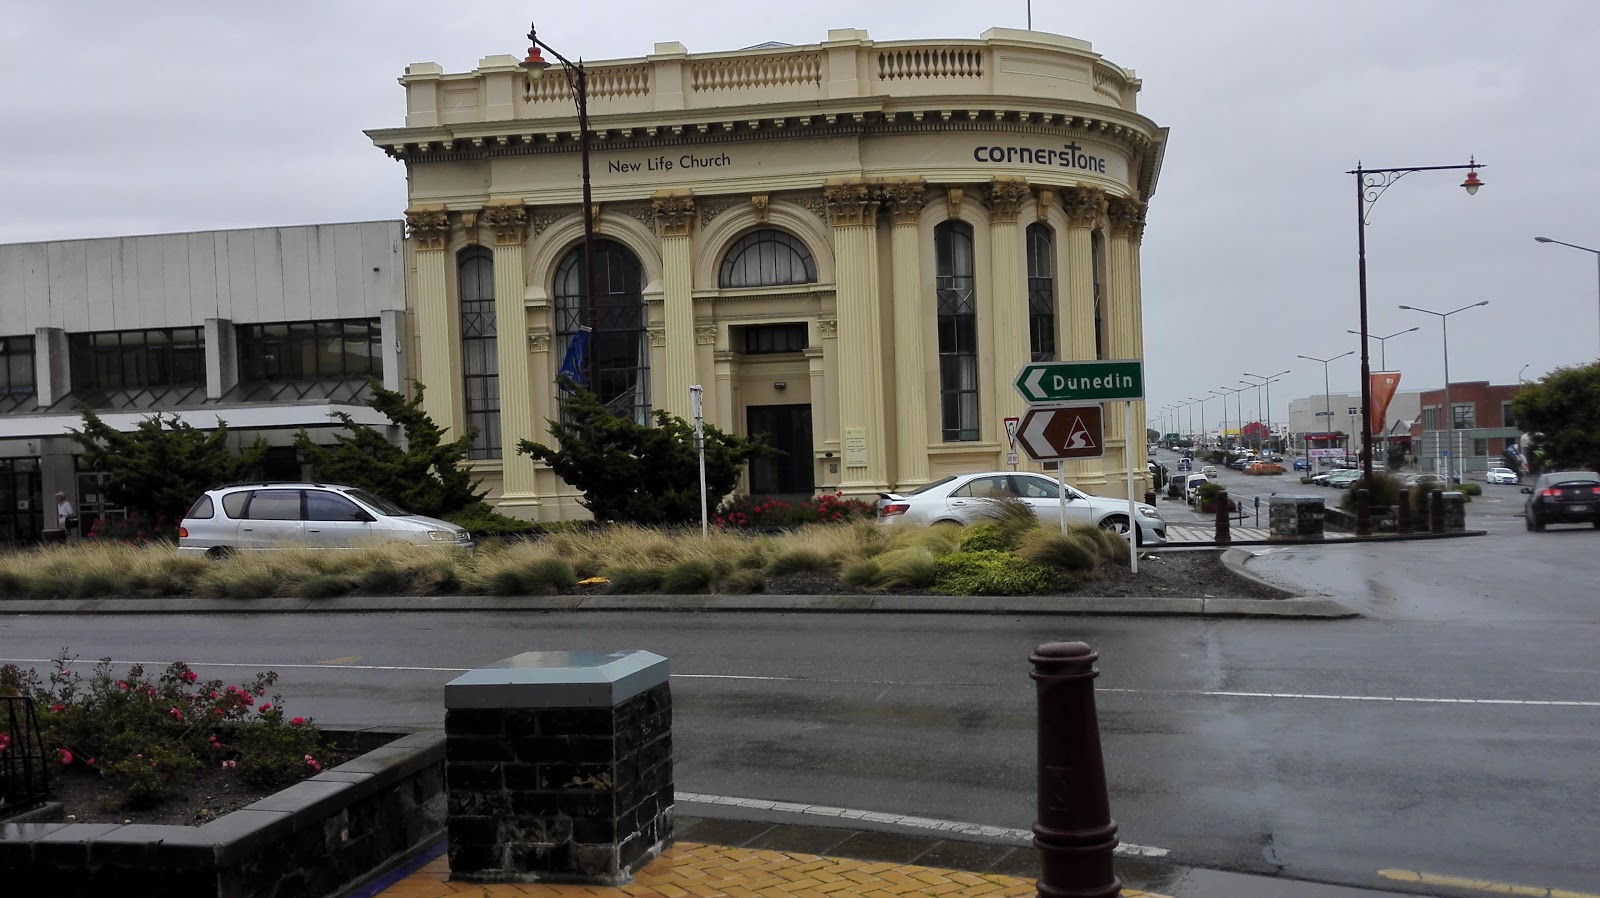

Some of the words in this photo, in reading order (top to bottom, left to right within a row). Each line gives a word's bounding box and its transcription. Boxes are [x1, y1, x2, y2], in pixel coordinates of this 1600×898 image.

[608, 160, 641, 173] New
[648, 156, 673, 171] Life
[680, 152, 731, 169] Church
[1053, 373, 1133, 391] Dunedin
